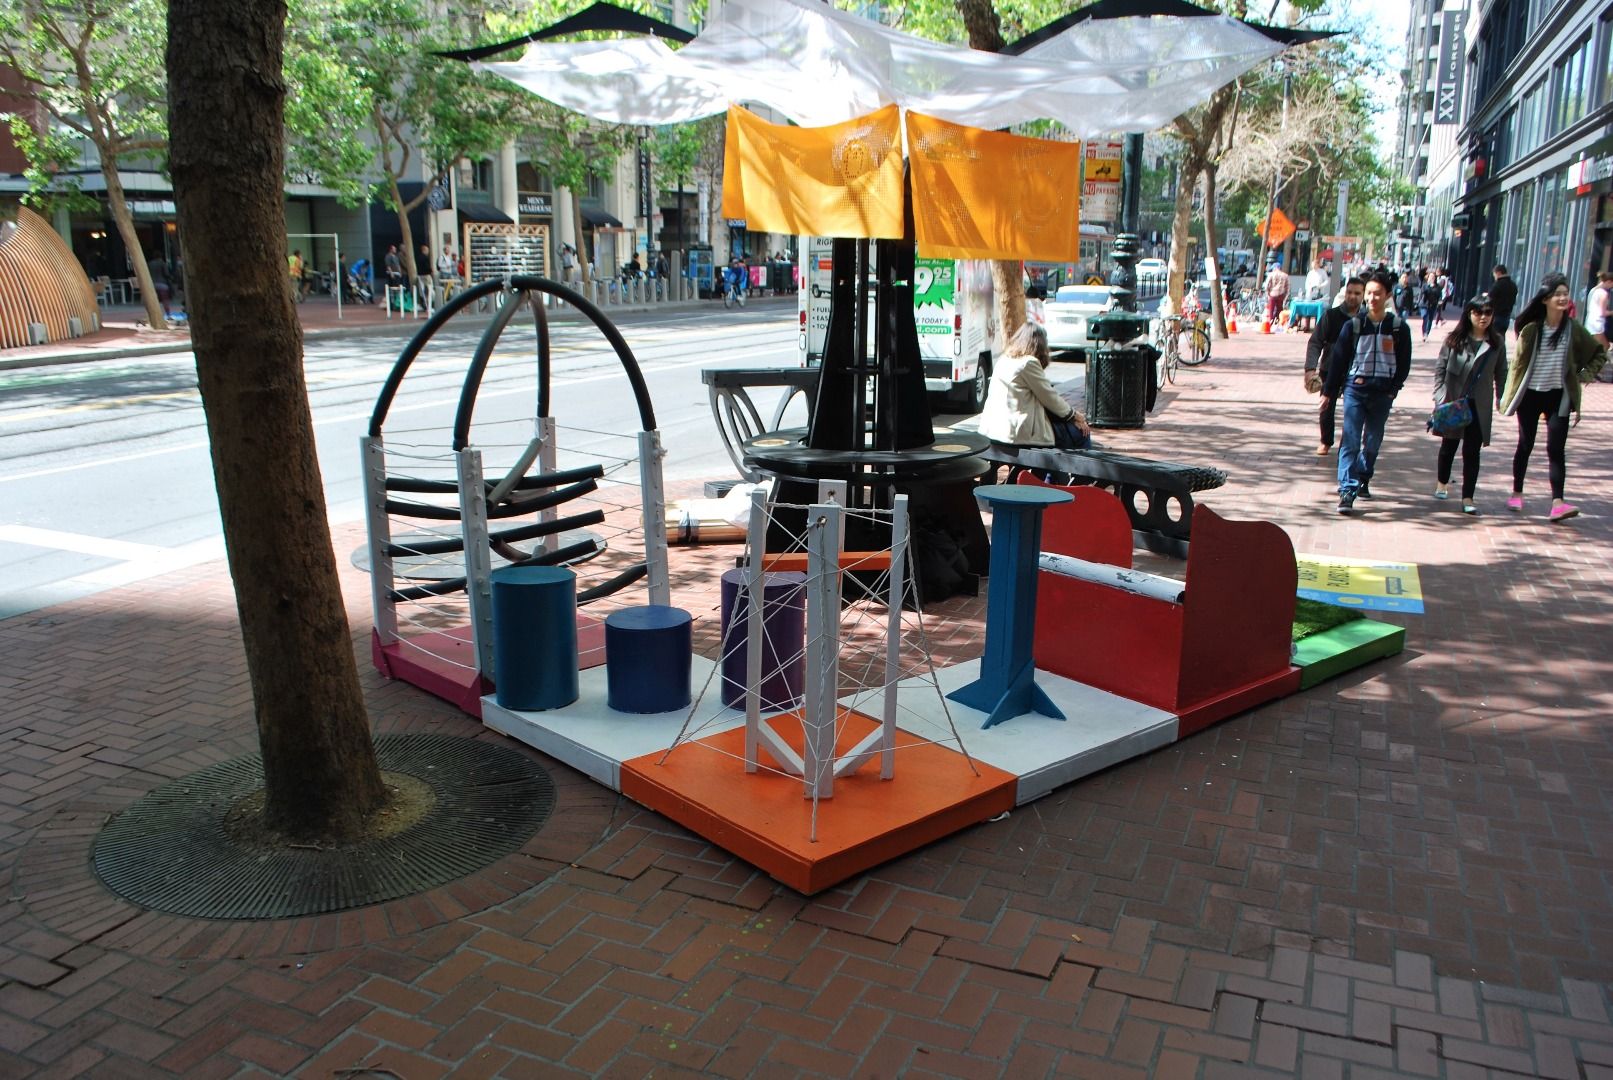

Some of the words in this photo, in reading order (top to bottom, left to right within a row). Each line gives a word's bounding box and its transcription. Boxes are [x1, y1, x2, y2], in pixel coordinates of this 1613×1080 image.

[1439, 82, 1456, 121] XXI
[1449, 14, 1462, 79] FOREVER
[1085, 184, 1095, 195] NO
[1096, 186, 1119, 195] PARKING
[1229, 238, 1239, 247] 10
[933, 266, 951, 279] 95
